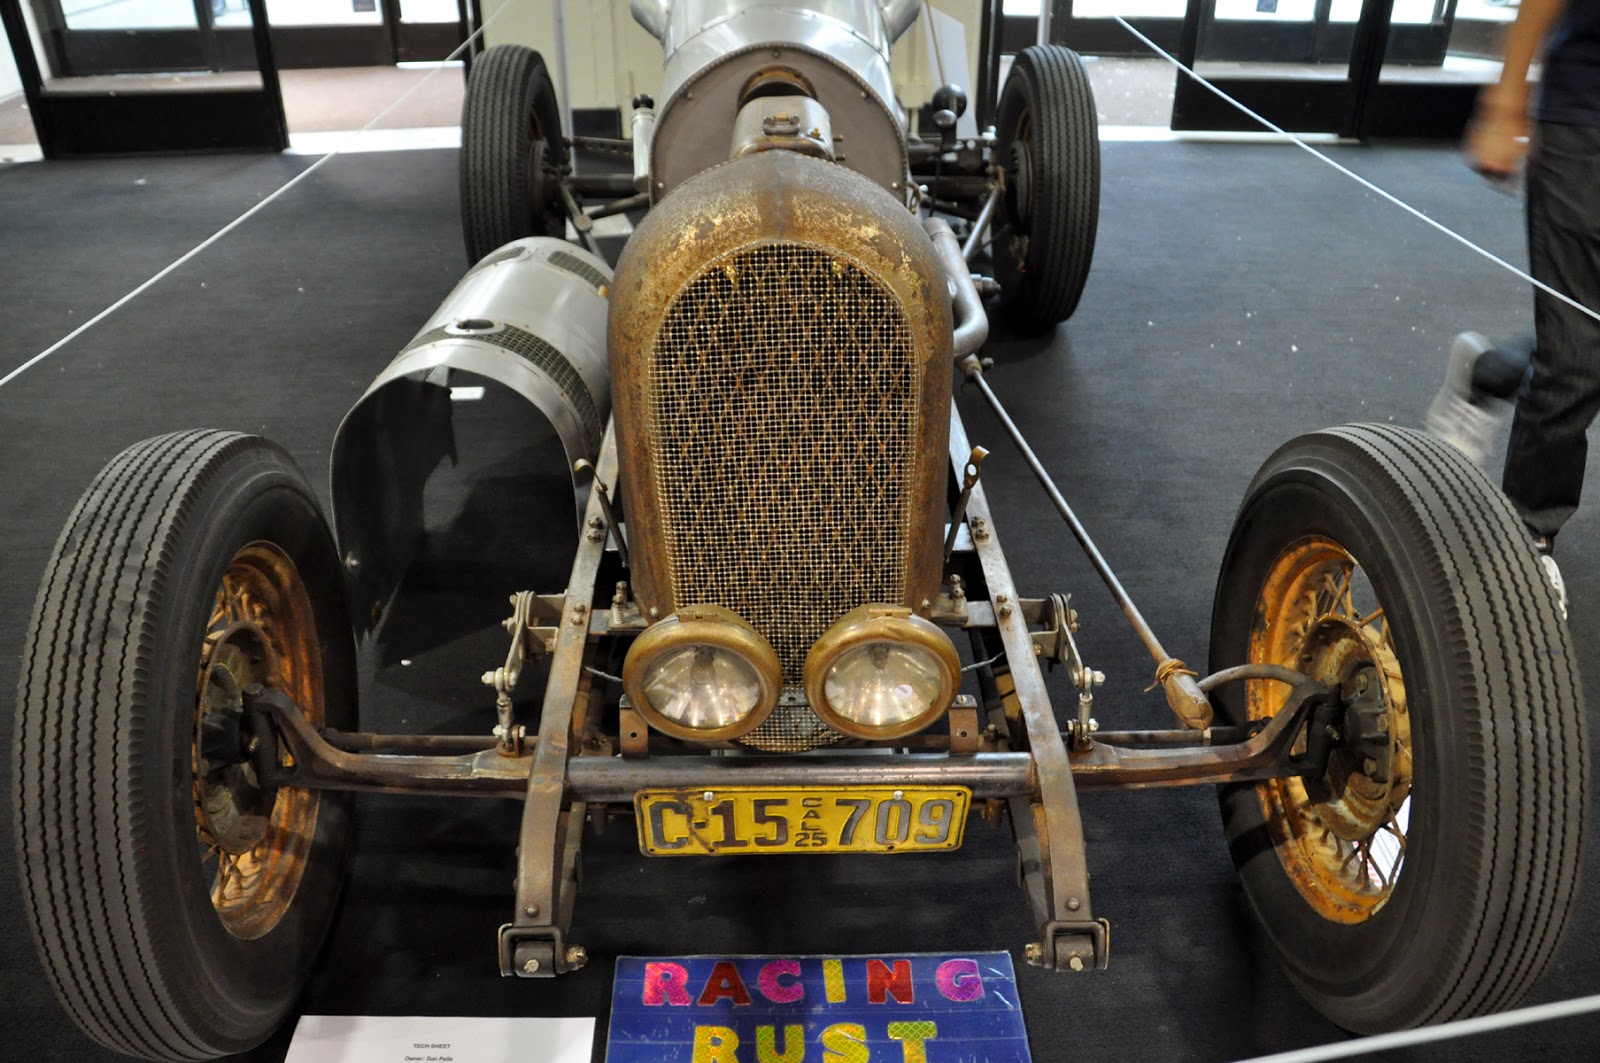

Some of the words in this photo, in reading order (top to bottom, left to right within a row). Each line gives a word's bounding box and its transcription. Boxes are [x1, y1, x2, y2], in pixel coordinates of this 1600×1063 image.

[802, 797, 822, 831] CAL
[836, 799, 954, 846] 709
[794, 832, 827, 847] 25
[642, 959, 985, 1006] RACING
[692, 1020, 938, 1063] RUST
